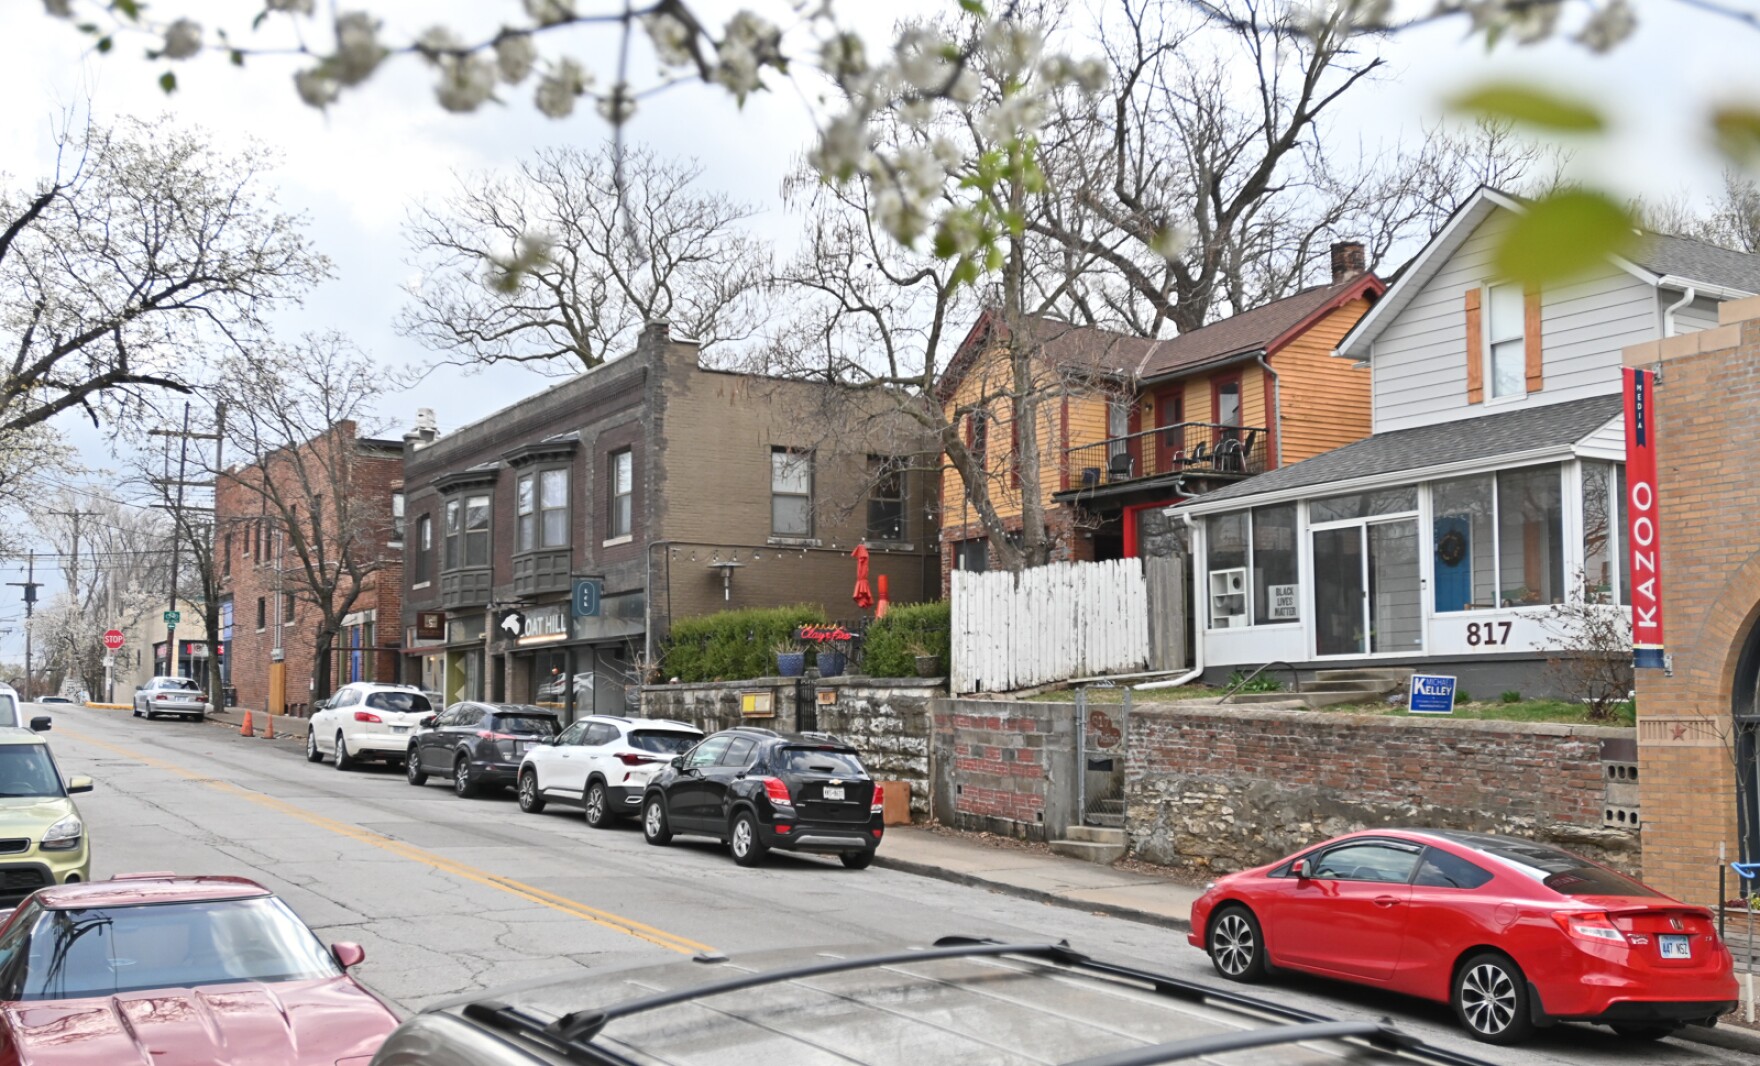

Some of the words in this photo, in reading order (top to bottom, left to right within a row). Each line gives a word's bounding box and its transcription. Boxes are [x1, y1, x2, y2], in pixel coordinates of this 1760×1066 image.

[1632, 482, 1657, 627] KAZOO
[1275, 587, 1294, 596] BLACK
[1276, 597, 1294, 606] LIVES
[1274, 607, 1296, 616] MATTER
[545, 613, 567, 634] HILL
[104, 635, 123, 643] STOP
[1467, 621, 1512, 646] 817
[1414, 678, 1452, 695] KELLEY
